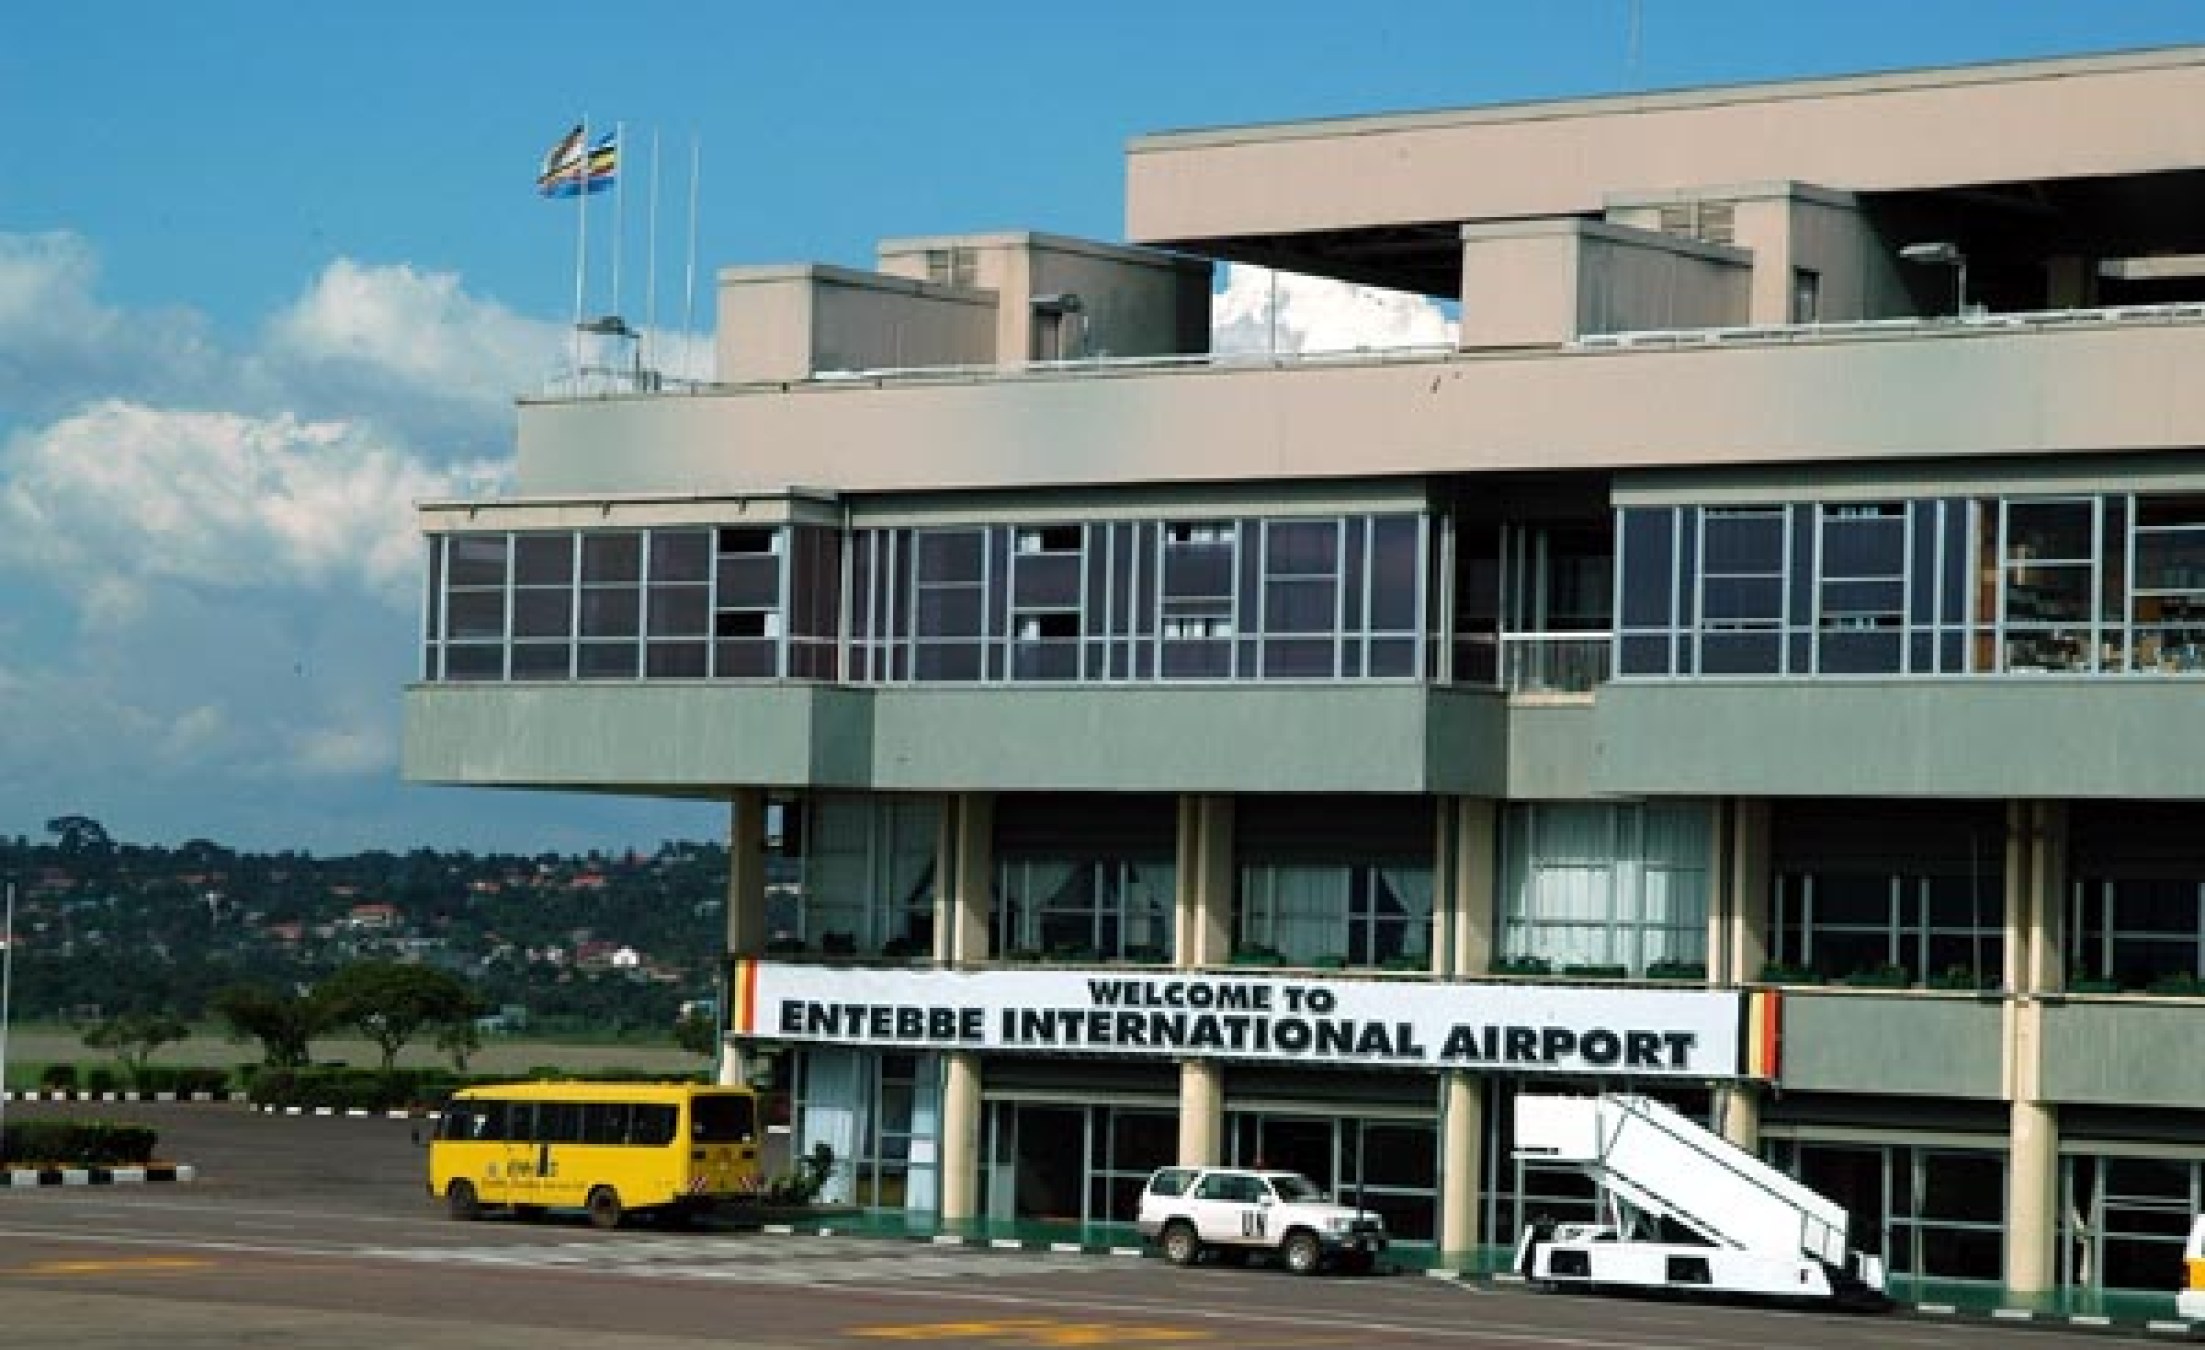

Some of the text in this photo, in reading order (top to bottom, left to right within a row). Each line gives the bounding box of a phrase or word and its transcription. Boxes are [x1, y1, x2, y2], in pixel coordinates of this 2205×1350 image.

[1087, 979, 1335, 1015] WELCOME TO
[780, 999, 1698, 1069] ENTEBBE INTERNATIONAL AIRPORT
[1241, 1209, 1268, 1237] UN
